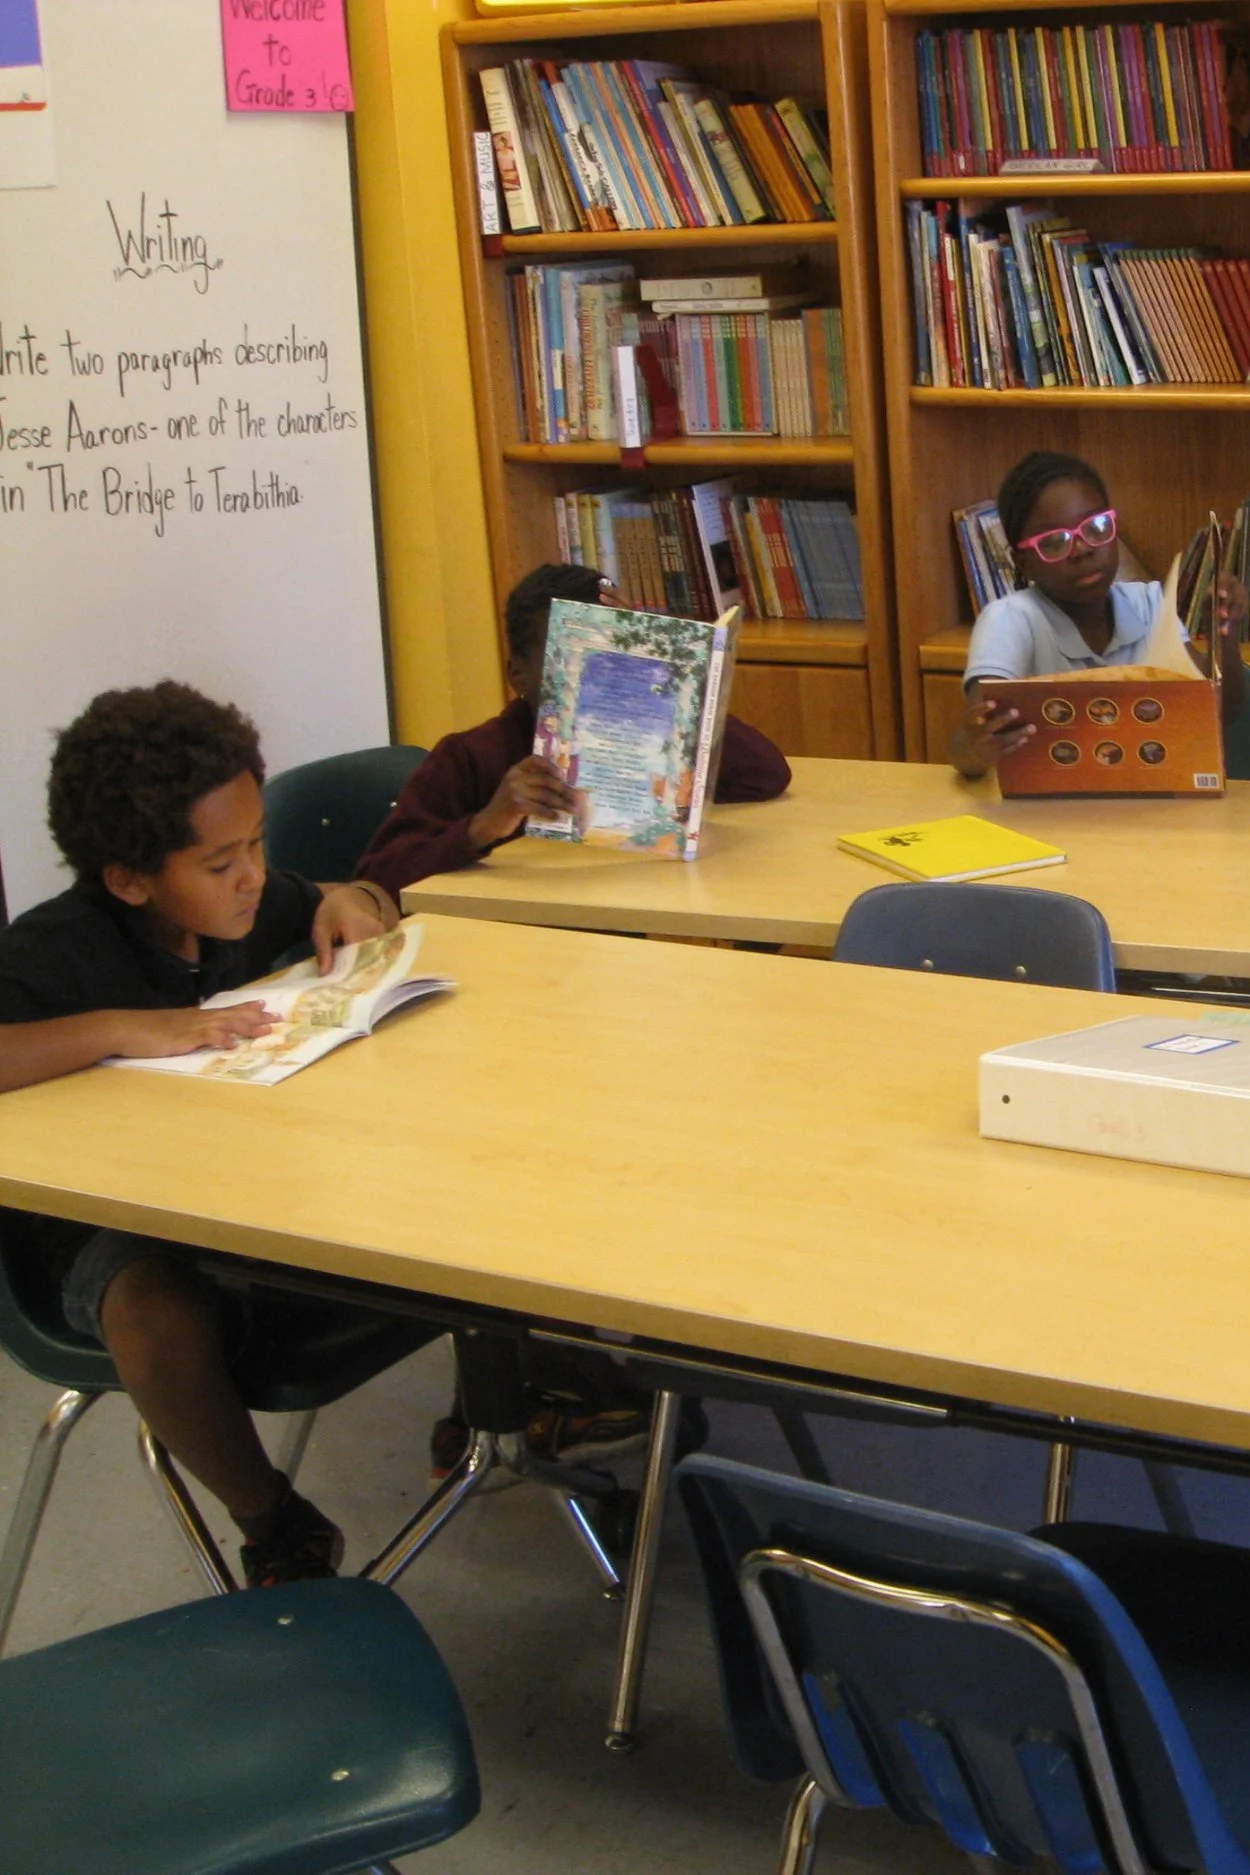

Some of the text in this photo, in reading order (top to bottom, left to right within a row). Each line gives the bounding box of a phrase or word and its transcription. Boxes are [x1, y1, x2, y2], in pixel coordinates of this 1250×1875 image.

[262, 34, 293, 67] to
[235, 69, 295, 108] Grade
[479, 132, 494, 174] MUSIC
[481, 203, 498, 234] ART
[106, 191, 208, 294] Writing
[0, 322, 329, 398] rite two paragraphs describing
[167, 416, 200, 440] one
[208, 396, 228, 436] of
[236, 397, 267, 439] the
[277, 393, 358, 437] characters
[0, 475, 25, 513] in
[102, 463, 176, 538] Bridge
[183, 466, 204, 513] to
